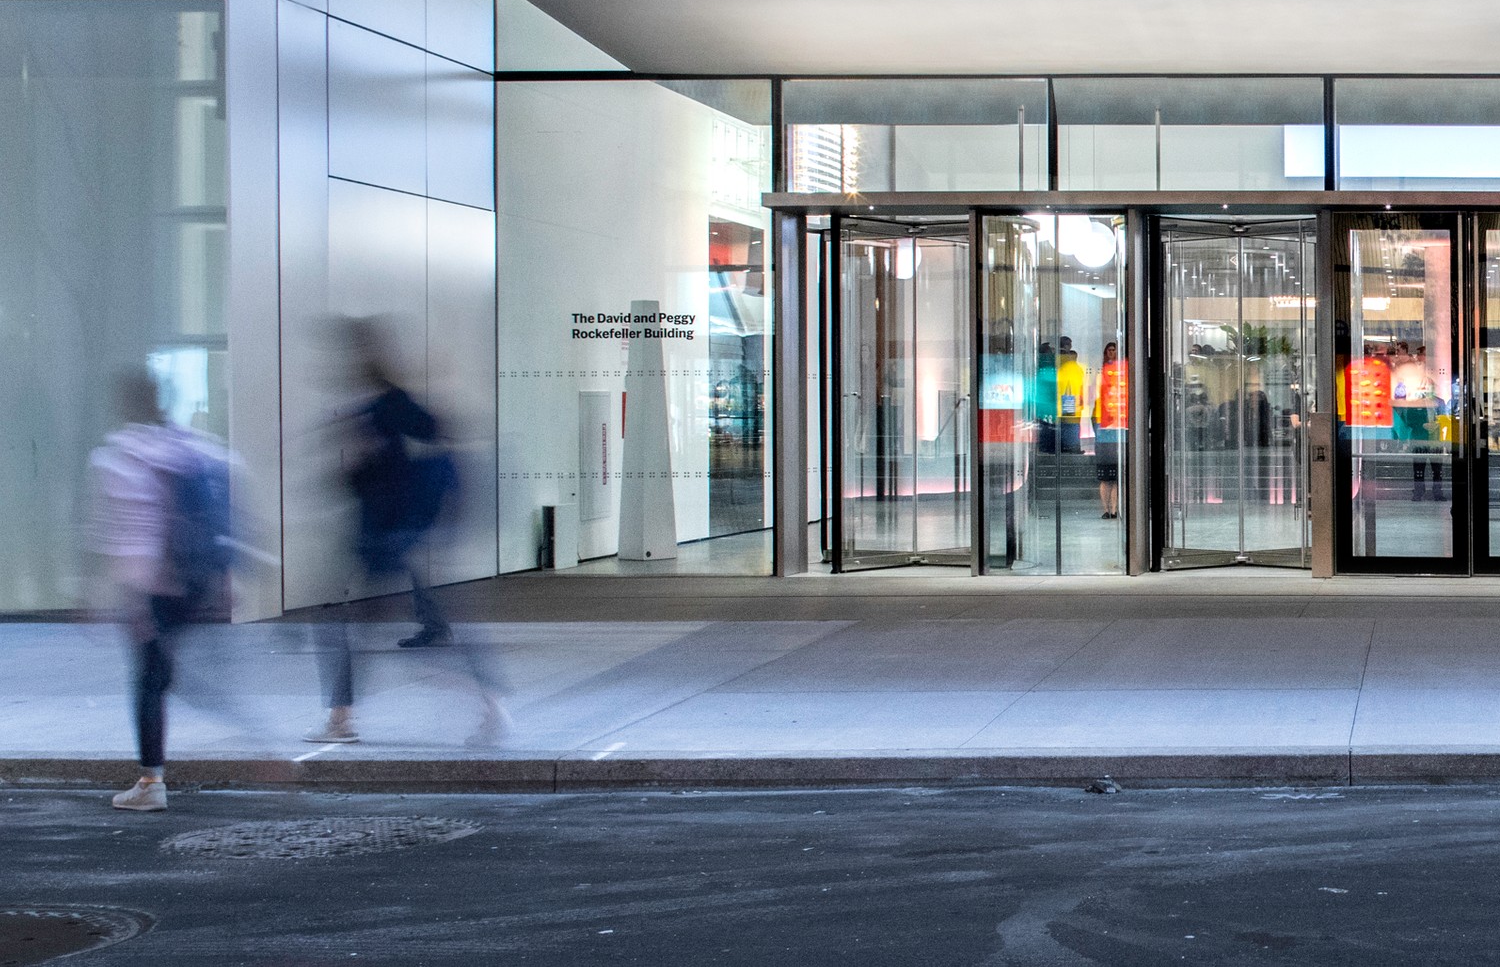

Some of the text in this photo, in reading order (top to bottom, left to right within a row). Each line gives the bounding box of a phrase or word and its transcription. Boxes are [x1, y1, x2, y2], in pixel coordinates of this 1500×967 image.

[571, 313, 696, 325] The David and Peggy
[571, 328, 642, 339] Rockefeller
[644, 328, 695, 340] Building
